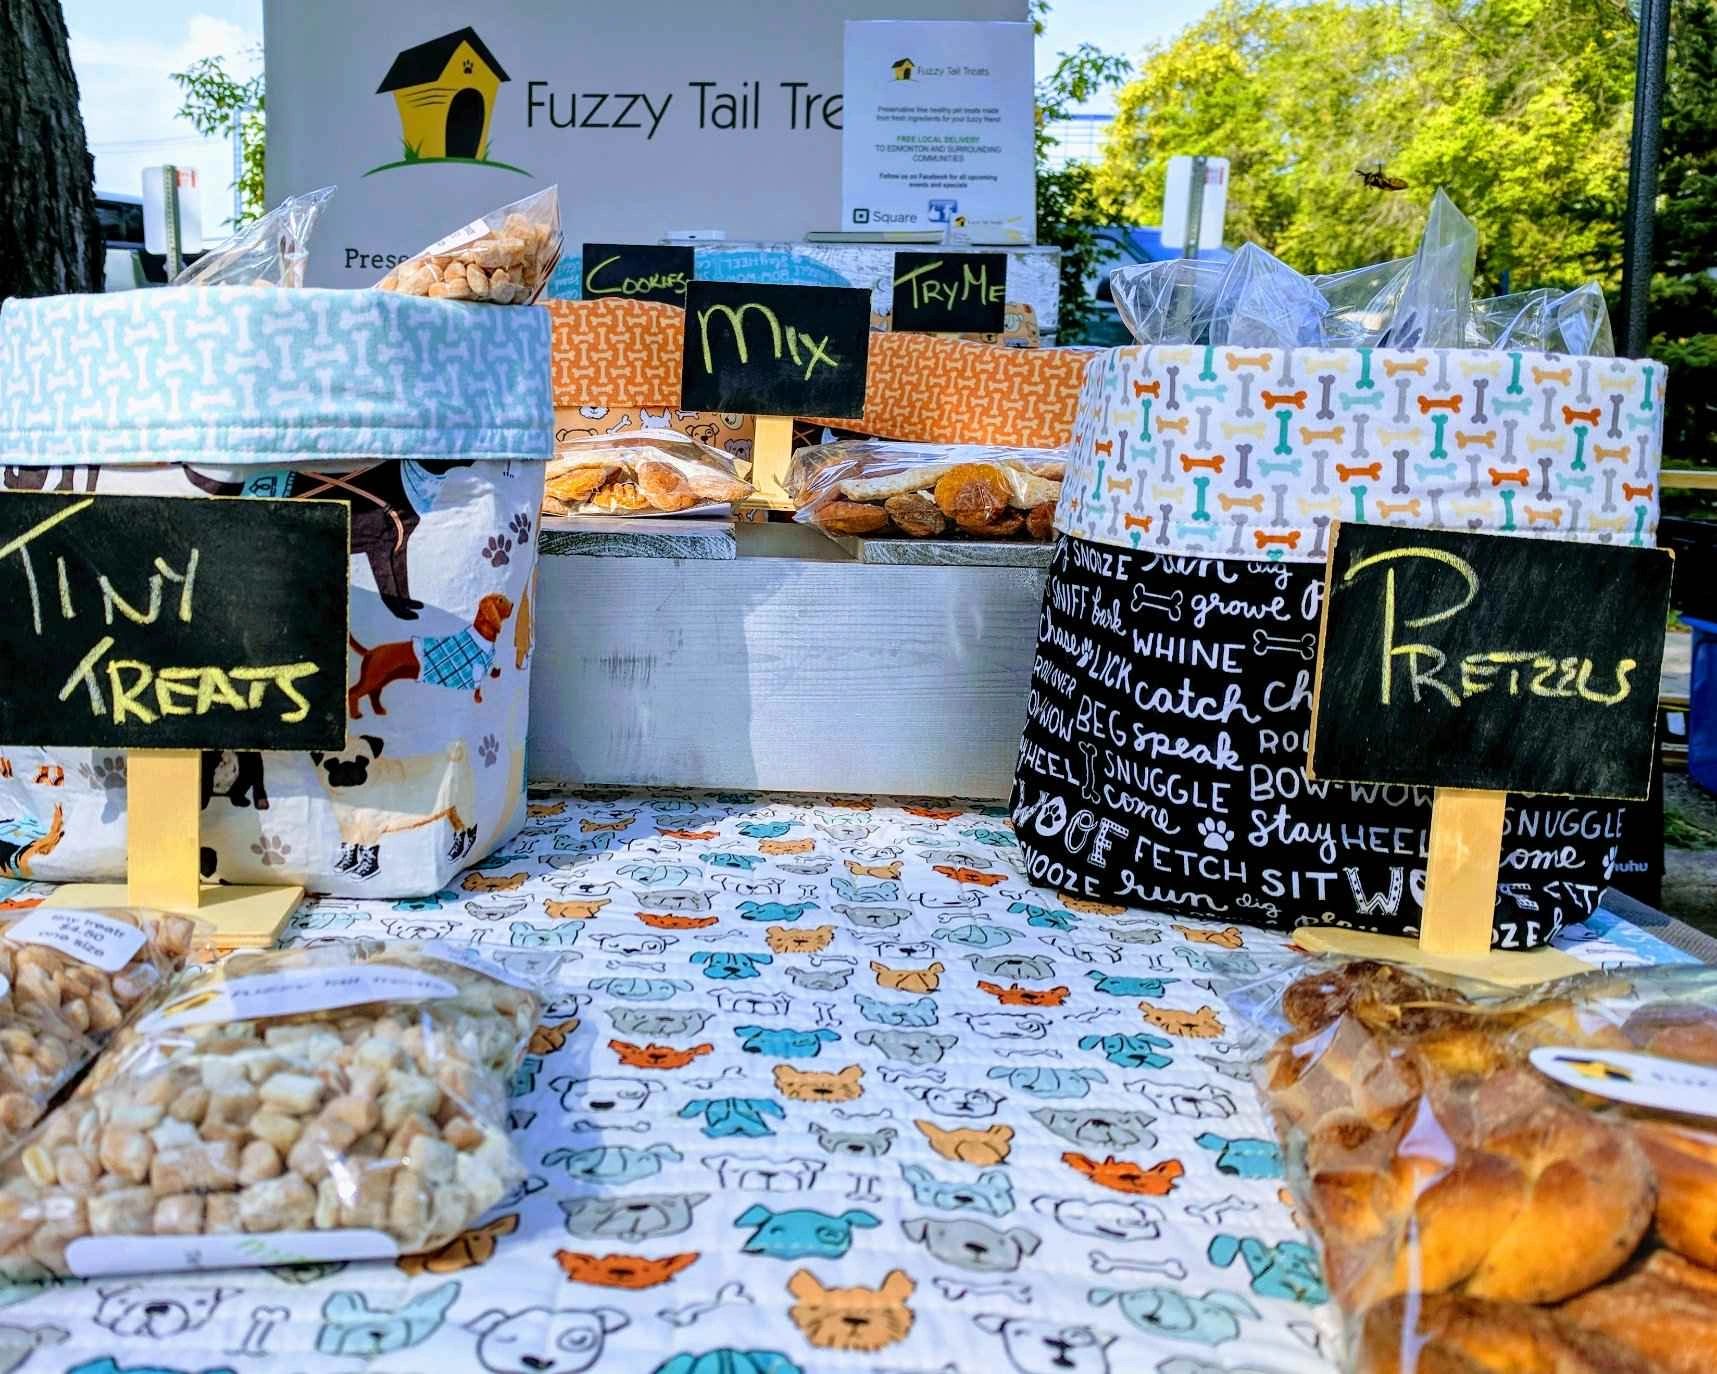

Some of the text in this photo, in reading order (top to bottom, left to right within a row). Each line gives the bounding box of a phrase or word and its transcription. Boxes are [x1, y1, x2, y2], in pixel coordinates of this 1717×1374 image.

[963, 66, 990, 76] Treats
[527, 81, 843, 140] Fuzzy Tail Tre
[873, 211, 918, 224] Square
[1088, 644, 1132, 694] LICK
[1133, 628, 1246, 674] WHINE
[58, 636, 320, 725] TREATS
[1135, 678, 1262, 724] catch
[1076, 694, 1127, 747] BEG
[1133, 722, 1244, 772] speak
[1104, 750, 1231, 814] SNUGGLE
[1103, 784, 1181, 835] come
[1020, 841, 1101, 898] NOOZE
[1135, 835, 1247, 884] FETCH
[1261, 868, 1339, 901] SIT
[1500, 846, 1586, 871] ome
